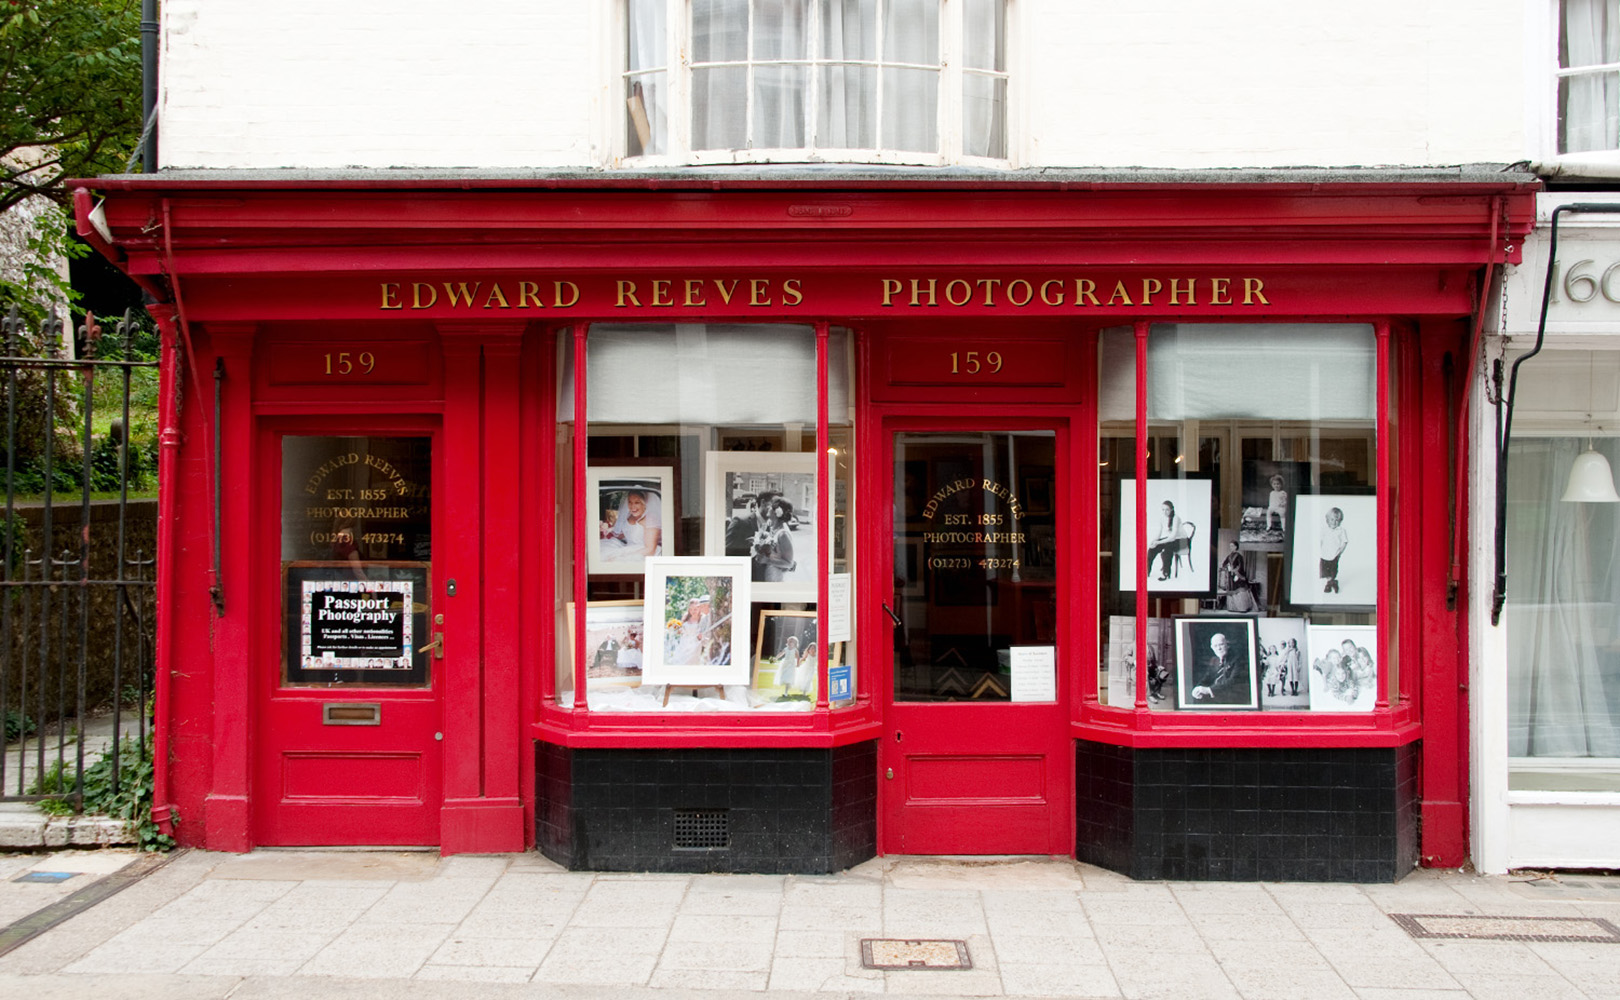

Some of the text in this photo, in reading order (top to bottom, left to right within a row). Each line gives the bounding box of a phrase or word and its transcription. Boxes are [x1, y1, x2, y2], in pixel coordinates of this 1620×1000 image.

[379, 278, 1271, 310] EDWARD REEVES PHOTOGRAPHER
[324, 351, 375, 376] 159
[950, 351, 1004, 375] 159
[305, 453, 360, 495] EDWARD
[364, 454, 409, 496] REEVES
[327, 489, 387, 500] EST. 1855
[922, 478, 1026, 520] EDWARD REEVES
[307, 507, 409, 518] PHOTOGRAPHER
[944, 514, 1004, 525] EST. 1855
[310, 531, 404, 545] (01273) 473274
[923, 532, 1026, 543] PHOTOGRAPHER
[928, 557, 1020, 570] (01273) 473274
[324, 595, 389, 611] Passport
[318, 609, 397, 624] Photography
